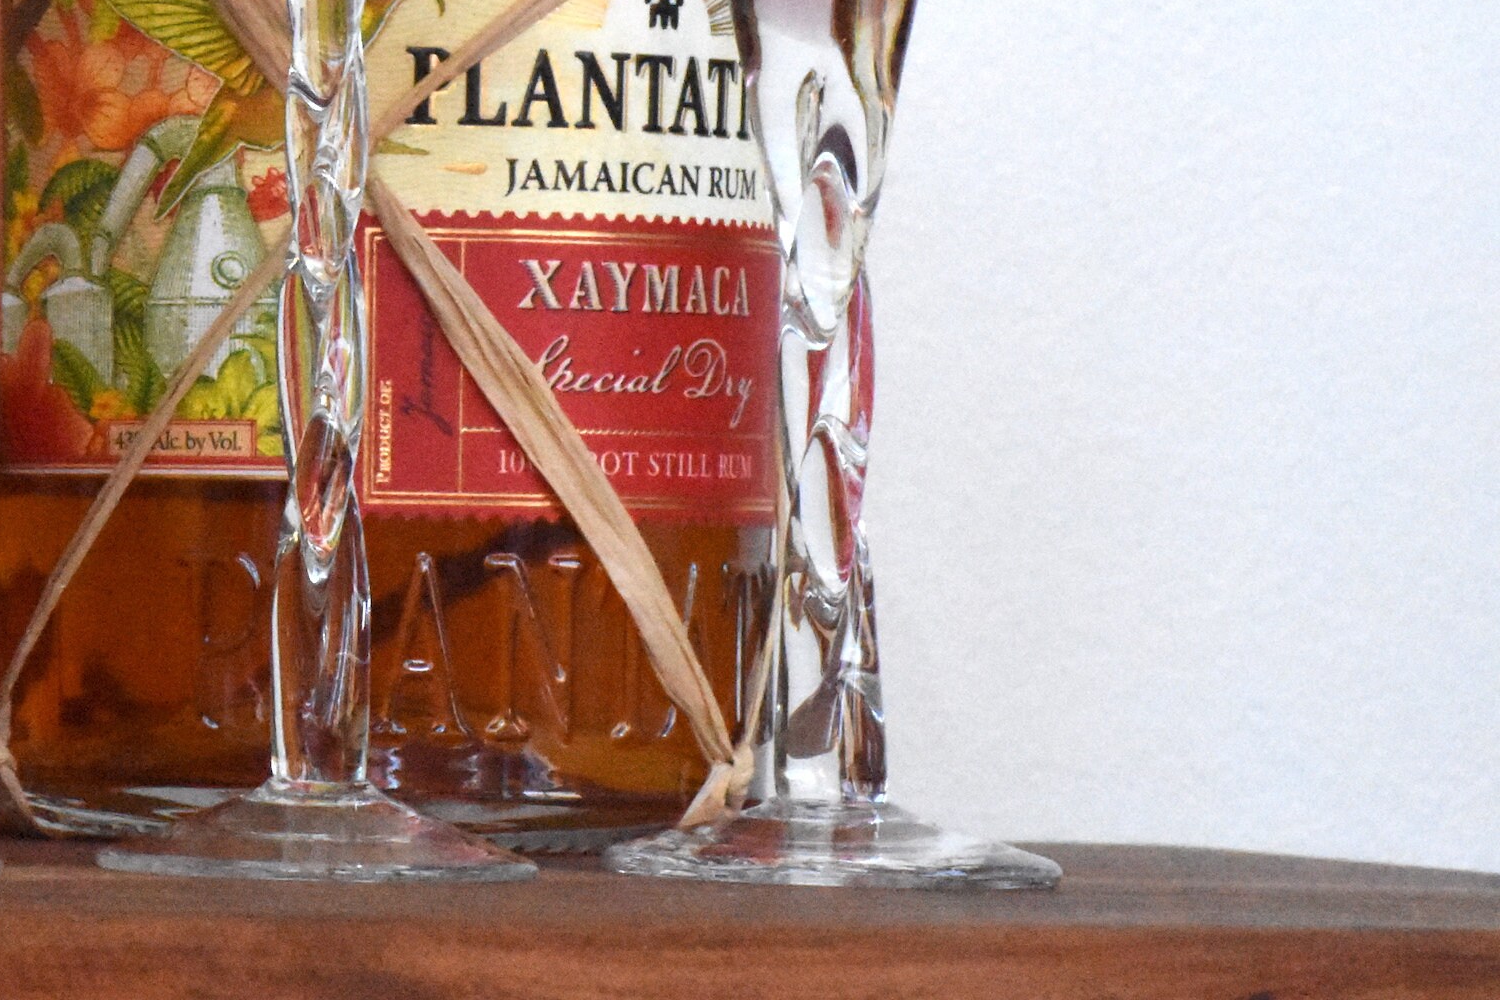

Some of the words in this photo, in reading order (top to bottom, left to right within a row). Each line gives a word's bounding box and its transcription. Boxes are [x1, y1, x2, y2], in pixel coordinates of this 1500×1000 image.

[503, 158, 701, 197] JAMAICAN
[708, 166, 757, 200] RUM
[518, 258, 750, 316] XAYMACA
[538, 334, 682, 394] Special
[683, 338, 753, 429] Dry
[185, 431, 206, 456] by
[209, 431, 242, 451] Vol.
[374, 409, 393, 484] PRODUCT
[648, 453, 713, 478] STILL
[718, 455, 753, 479] RUM
